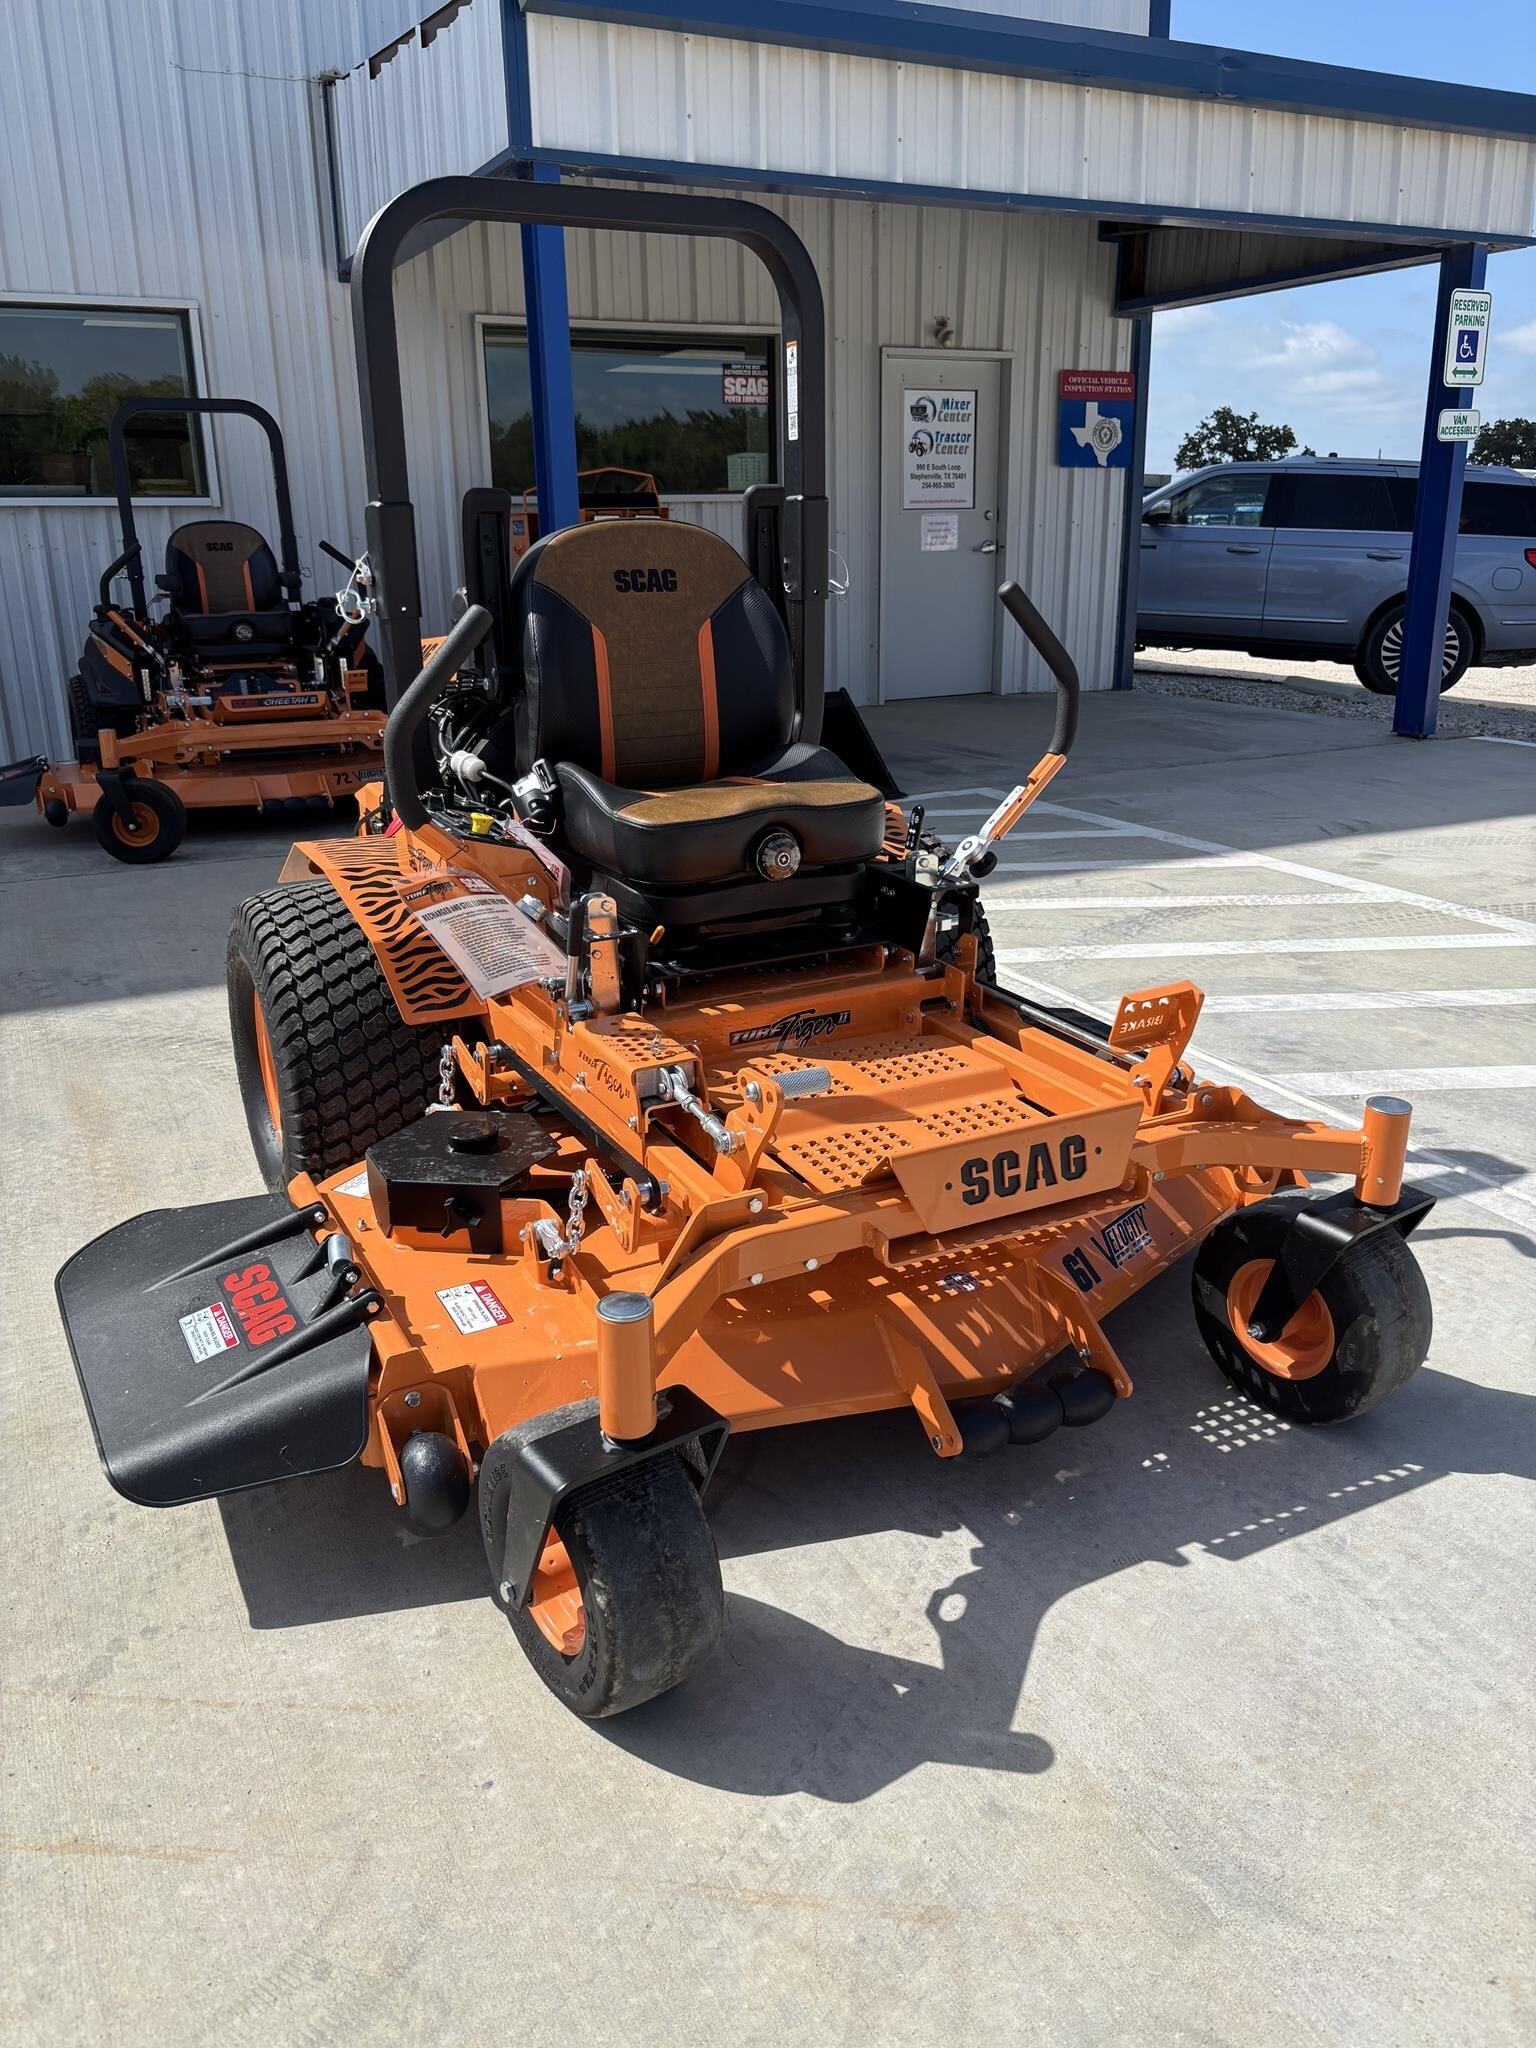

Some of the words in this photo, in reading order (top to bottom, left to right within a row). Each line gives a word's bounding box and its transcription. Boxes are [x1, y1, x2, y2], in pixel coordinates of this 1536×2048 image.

[1453, 298, 1489, 313] RESERVED
[1454, 314, 1485, 327] PARKING
[724, 377, 768, 396] SCAG
[1068, 376, 1099, 384] OFFICIAL
[1100, 377, 1129, 385] VEHICLE
[1064, 384, 1104, 392] INSPECTION
[1104, 385, 1132, 393] STATION
[724, 395, 742, 403] POWER
[940, 398, 971, 411] Mixer
[937, 410, 972, 423] Center
[1453, 414, 1468, 425] VAN
[1440, 425, 1478, 435] ACCESSIBLE
[935, 431, 972, 443] Tractor
[935, 443, 970, 455] Center
[948, 464, 962, 472] Loop
[910, 473, 943, 481] Stephenville,
[205, 542, 234, 553] SCAG
[613, 567, 678, 594] SCAG
[264, 697, 309, 706] CHEETAH
[333, 772, 353, 785] 72
[404, 888, 429, 901] TURF
[421, 906, 452, 921] RECHARGED
[450, 903, 462, 913] AND
[730, 1023, 785, 1046] TURF
[775, 1008, 839, 1052] Tiger
[838, 1013, 850, 1025] II
[578, 1049, 598, 1070] TURF
[594, 1058, 624, 1100] Tiger
[960, 1134, 1087, 1206] SCAG
[1062, 1246, 1102, 1292] 61
[1089, 1202, 1148, 1269] VELOCITY
[1116, 1232, 1153, 1267] PLUS
[224, 1263, 297, 1346] SCAG
[481, 1293, 508, 1321] DANGER
[216, 1315, 234, 1341] DANGER
